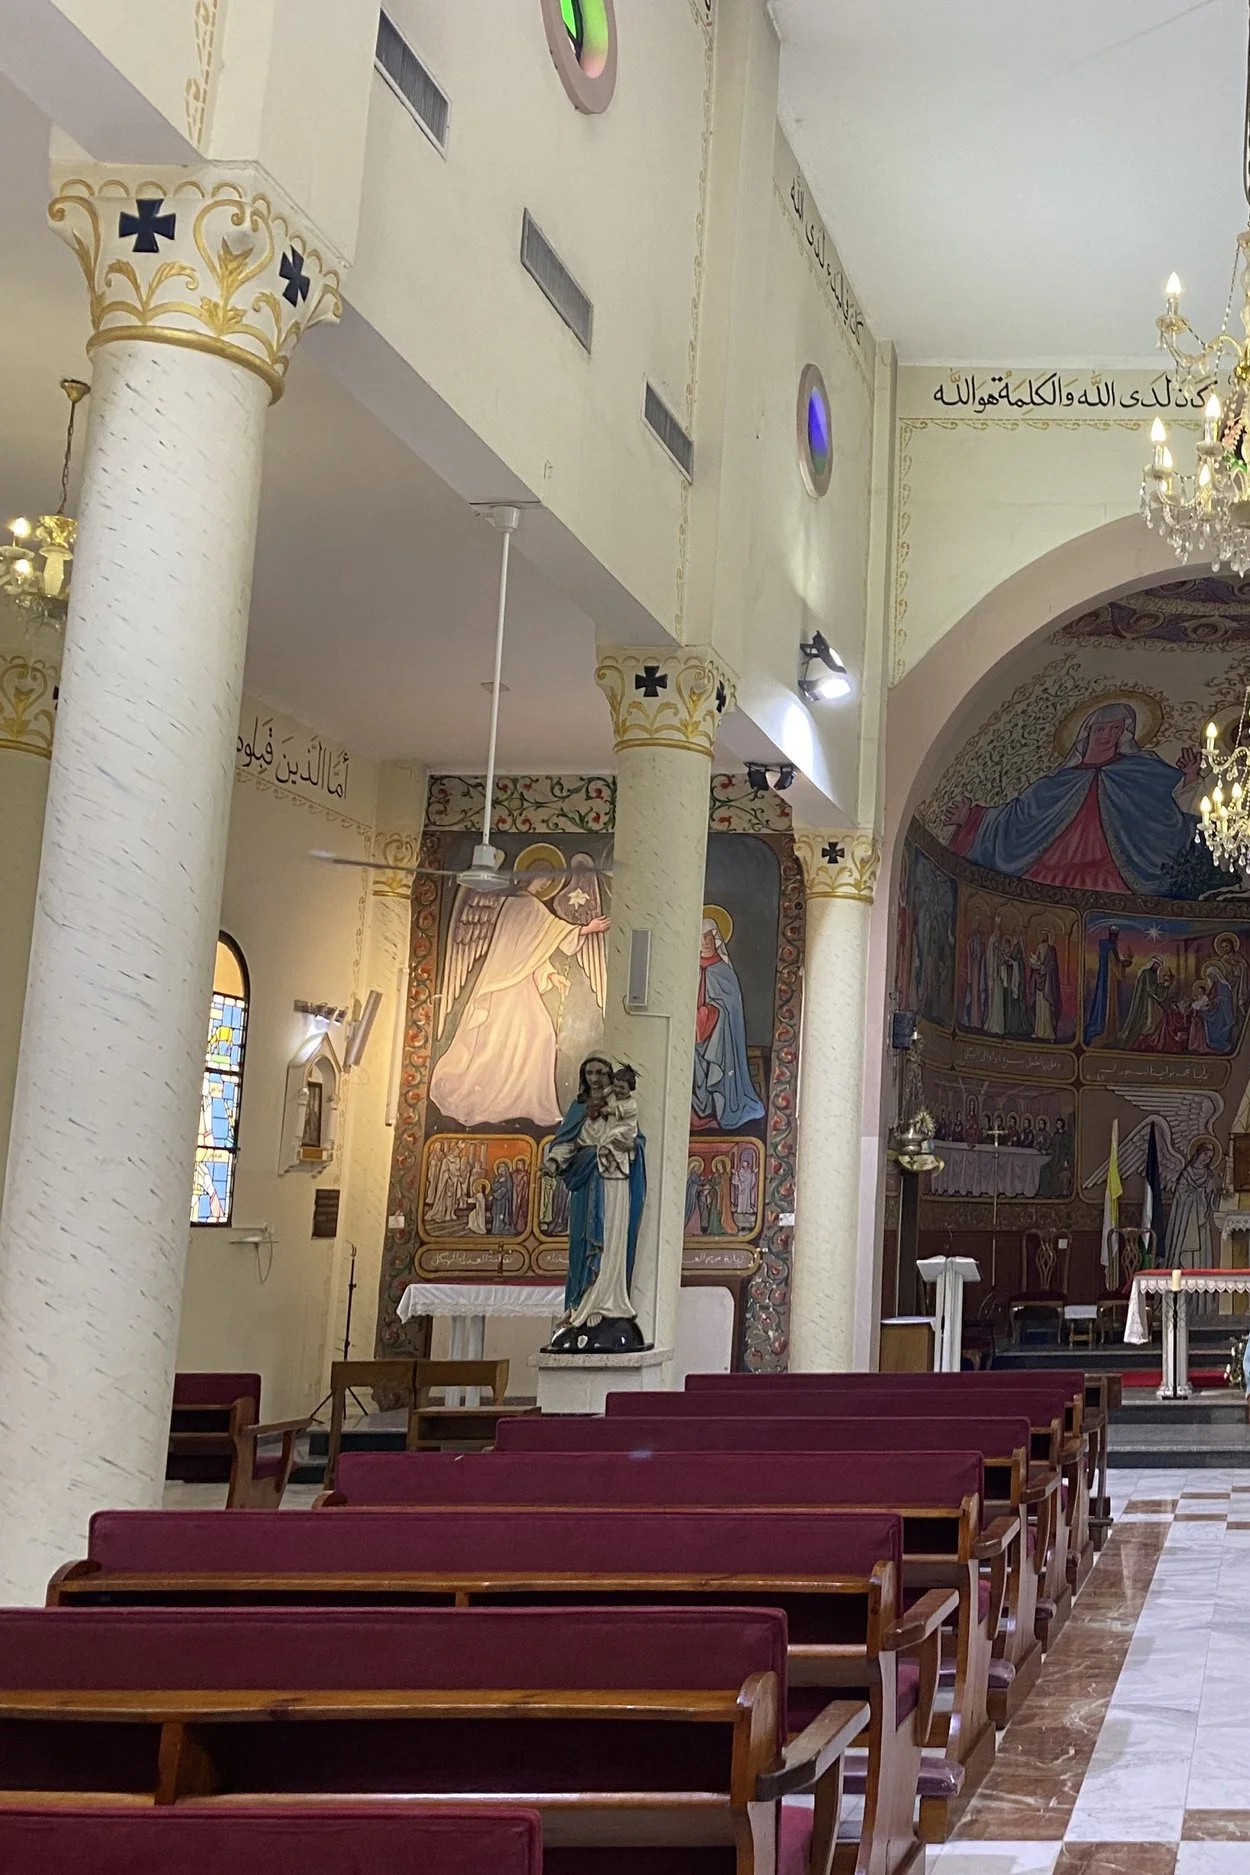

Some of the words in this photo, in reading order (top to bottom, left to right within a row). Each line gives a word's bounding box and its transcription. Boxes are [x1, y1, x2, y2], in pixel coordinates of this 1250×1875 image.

[934, 374, 976, 407] الله
[974, 392, 999, 414] هو
[991, 372, 1074, 409] والكلمة
[1078, 378, 1115, 408] الله
[1120, 374, 1172, 408] لدى
[275, 740, 326, 789] الذين
[327, 751, 349, 799] أما
